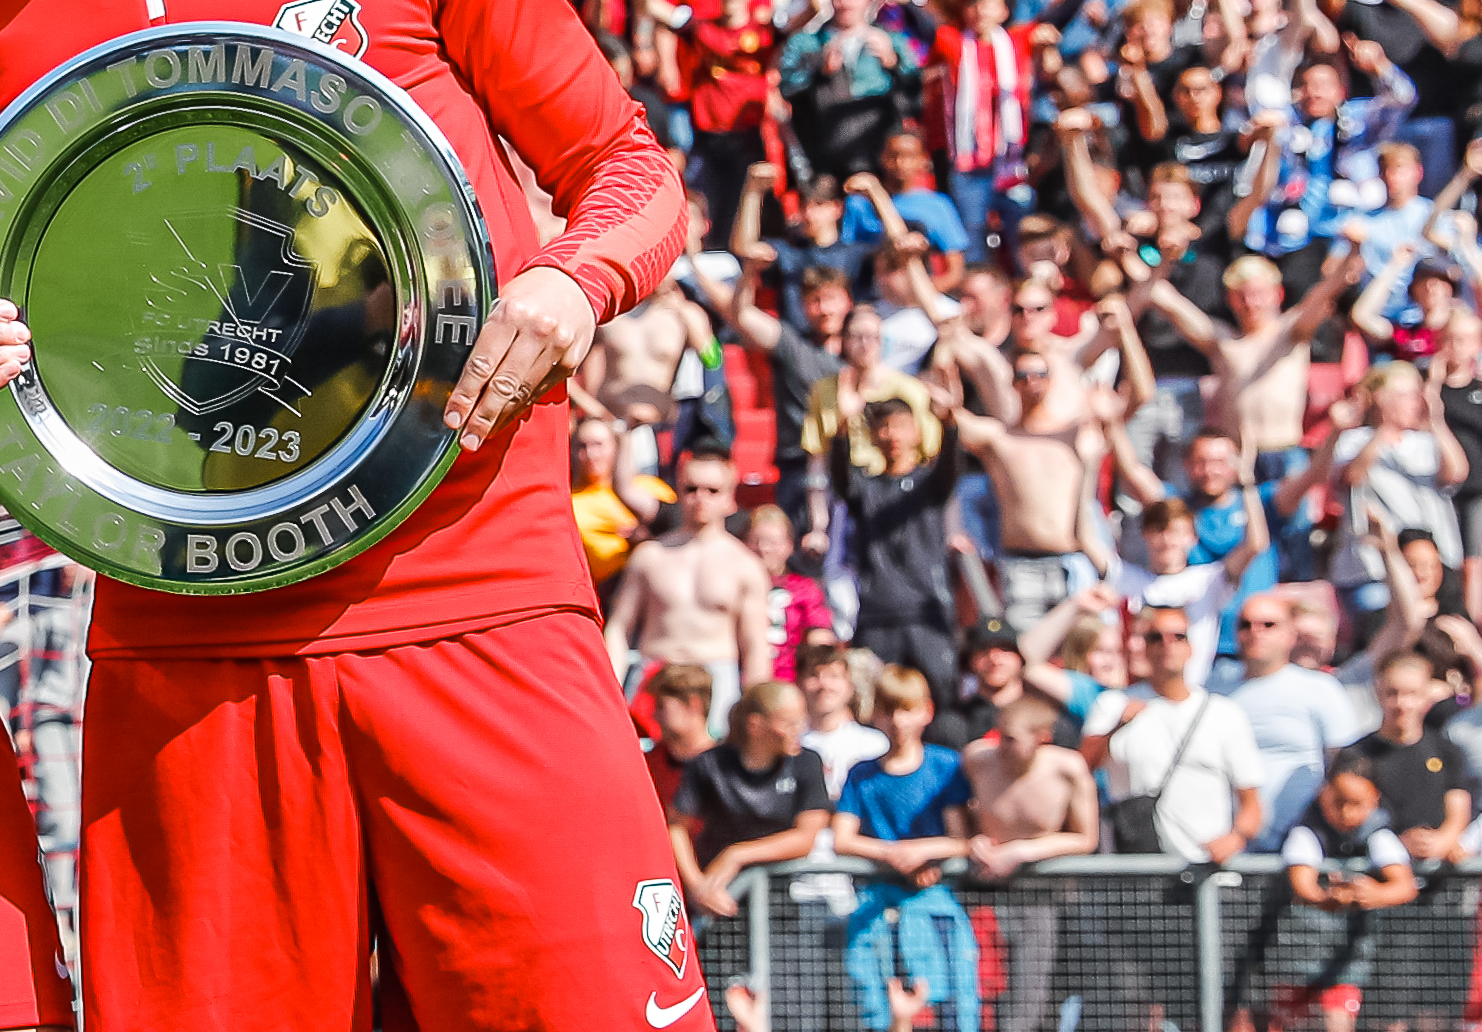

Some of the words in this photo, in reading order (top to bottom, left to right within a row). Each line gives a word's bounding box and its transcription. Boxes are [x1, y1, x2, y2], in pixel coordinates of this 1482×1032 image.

[295, 11, 307, 32] F
[311, 0, 350, 44] ECHT
[44, 77, 104, 135] DI
[107, 43, 383, 136] TOMMASO
[175, 141, 338, 219] PLAATS
[134, 336, 209, 357] Sinds
[220, 343, 281, 376] 1981
[178, 317, 283, 343] UTRECHT
[86, 403, 176, 444] 2022
[209, 421, 302, 464] 2023
[185, 483, 377, 575] BOOTH
